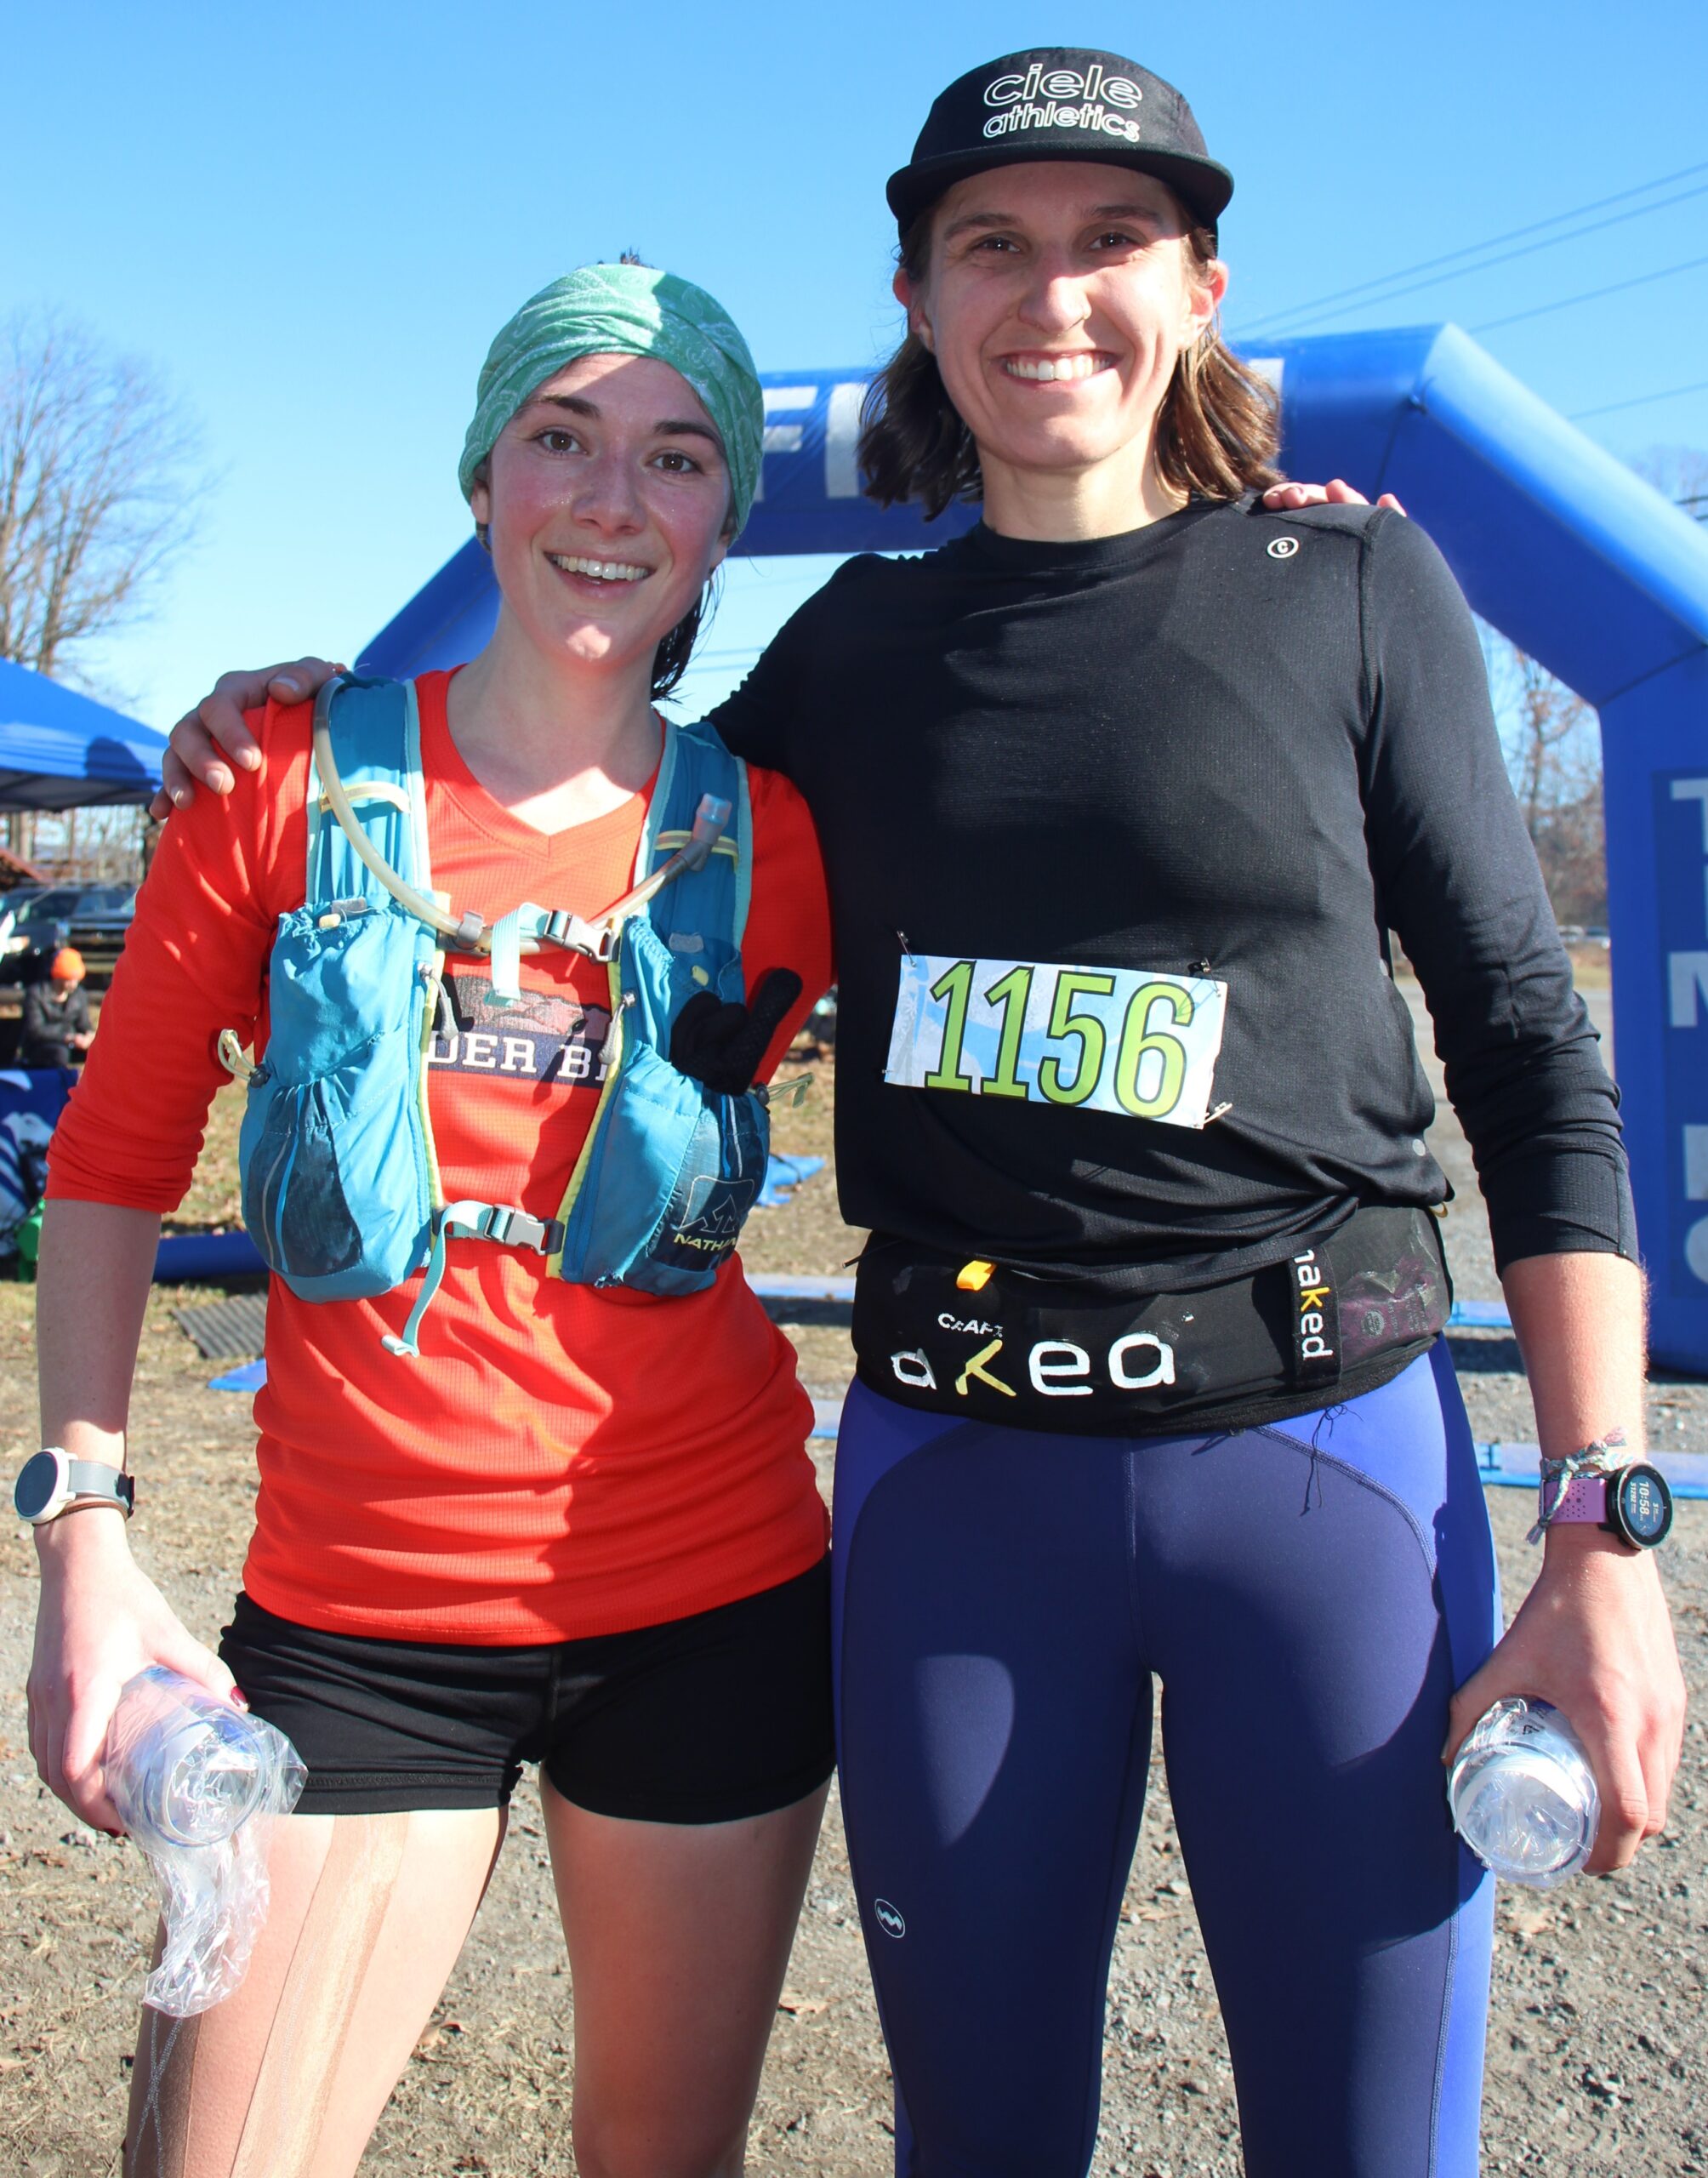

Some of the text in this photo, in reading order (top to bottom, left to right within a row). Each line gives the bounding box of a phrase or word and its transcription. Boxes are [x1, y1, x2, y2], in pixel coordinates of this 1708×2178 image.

[983, 63, 1142, 109] ciele
[982, 101, 1141, 143] athletics
[427, 1030, 537, 1073] DER
[924, 960, 1195, 1120] 1156
[673, 1233, 737, 1251] NATH
[1638, 1481, 1650, 1515] 10:58
